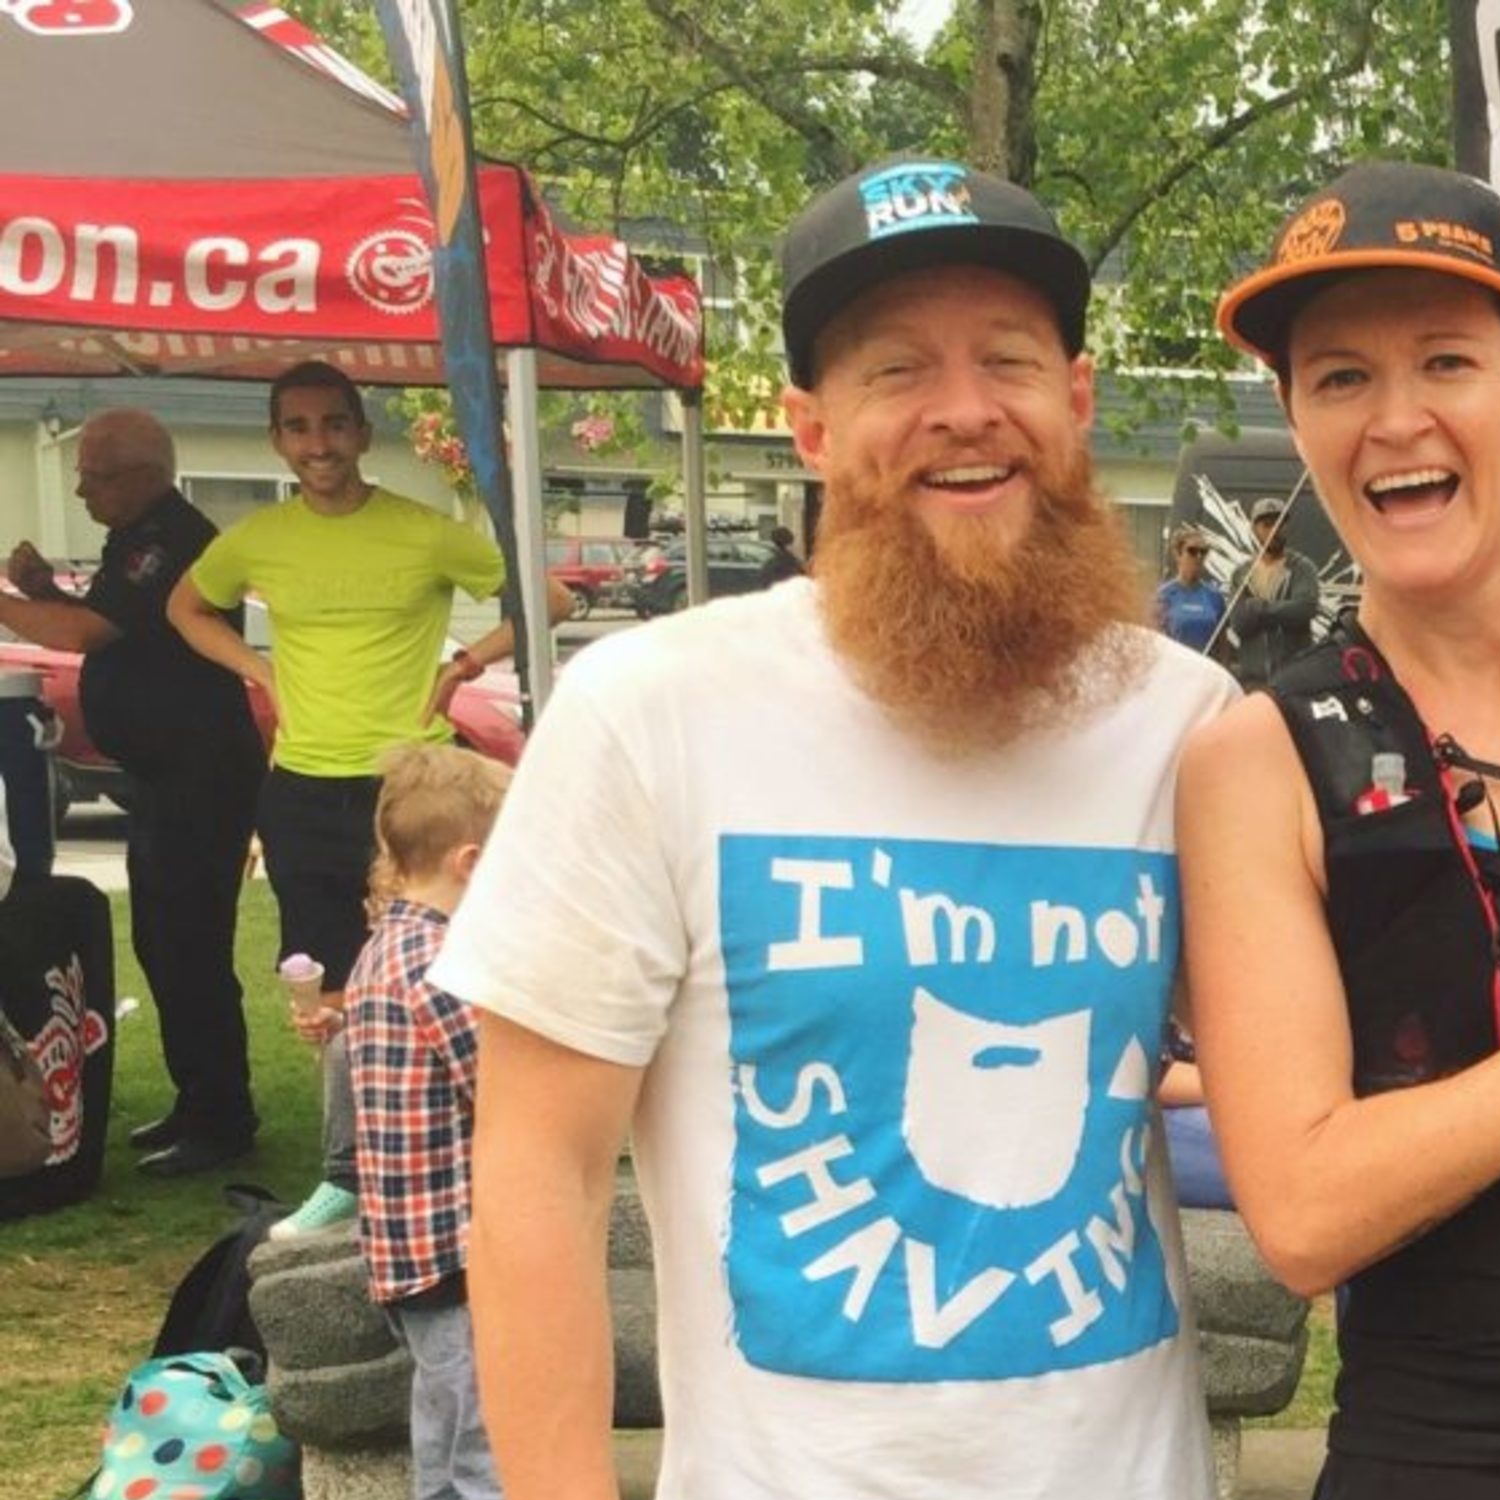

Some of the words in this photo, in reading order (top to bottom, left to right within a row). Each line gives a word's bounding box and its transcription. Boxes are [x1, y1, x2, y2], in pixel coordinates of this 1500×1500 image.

[866, 190, 963, 240] RUN
[767, 846, 995, 971] I'm
[1031, 873, 1165, 968] not
